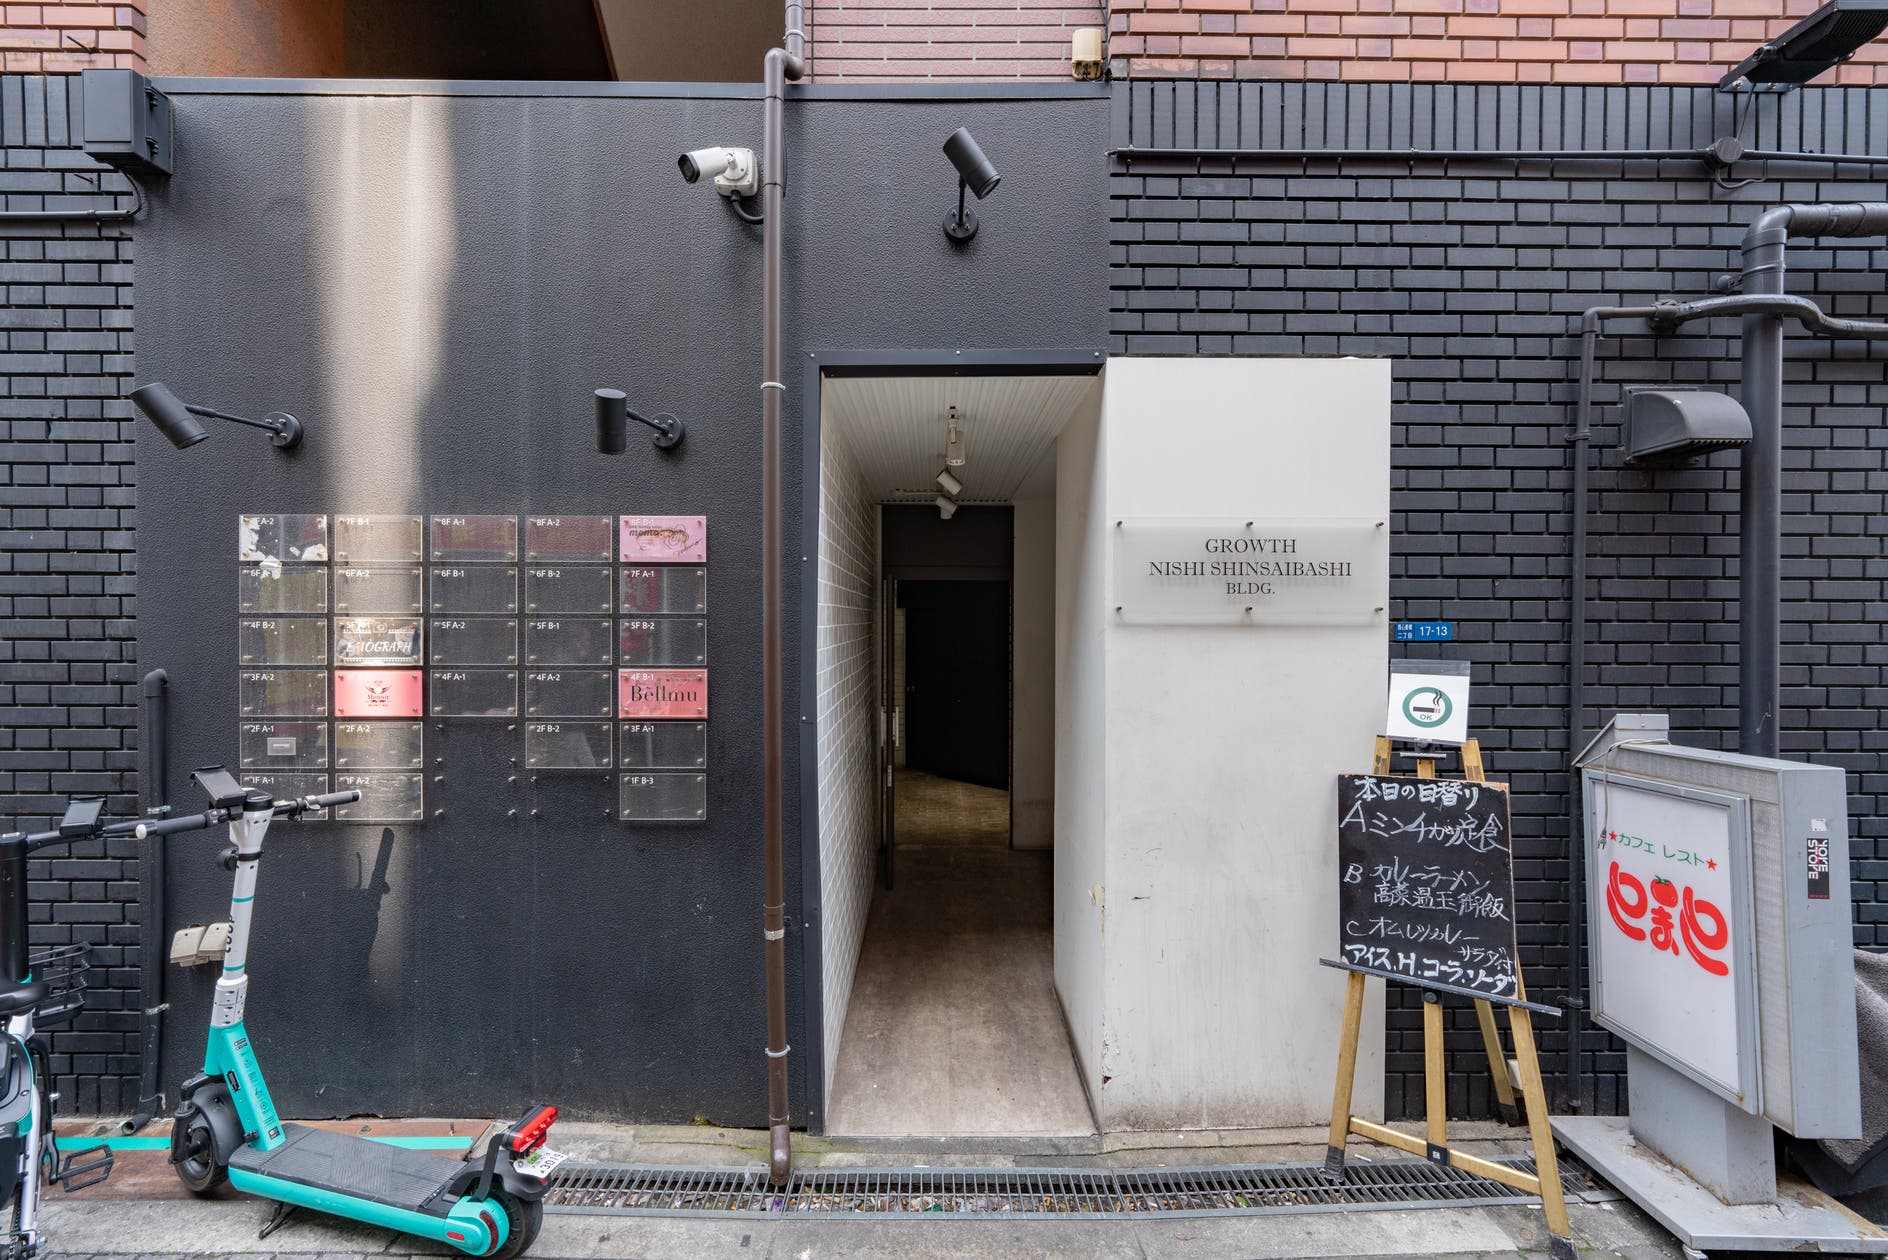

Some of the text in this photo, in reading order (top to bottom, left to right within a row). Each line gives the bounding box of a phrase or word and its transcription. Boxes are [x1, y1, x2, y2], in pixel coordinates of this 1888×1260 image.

[358, 517, 370, 526] B-1
[441, 517, 465, 526] 8F A-1
[536, 517, 561, 526] 8F A-2
[1204, 538, 1297, 554] GROWTH
[250, 569, 260, 578] 6F
[345, 569, 371, 578] 6F A-2
[441, 569, 465, 578] 6F B-1
[536, 569, 561, 578] 6F B-2
[631, 569, 656, 578] 7F A-1
[1148, 561, 1352, 577] NISHI SHINSAIBASHI
[1226, 582, 1276, 596] BLDG.
[250, 621, 275, 630] 4F B-2
[441, 621, 466, 630] 5F A-2
[536, 621, 560, 630] 5F B-1
[631, 621, 657, 630] 5F B-2
[1419, 626, 1448, 636] 17-13
[250, 673, 275, 681] 3F A-2
[441, 673, 465, 681] 4F A-1
[536, 673, 561, 681] 4F A-2
[631, 673, 656, 681] 4F B-1
[250, 724, 274, 733] 2F A-1
[345, 724, 371, 733] 2F A-2
[536, 724, 561, 733] 2F B-2
[631, 724, 656, 733] 3F A-1
[250, 776, 274, 785] 1F A-1
[345, 776, 371, 785] 1F A-2
[631, 776, 657, 785] 1F B-3
[1353, 776, 1479, 812] 本日の日替り
[1339, 800, 1366, 833] A
[1618, 832, 1706, 867] カフェ レスト
[1343, 856, 1491, 896] B カレーラーメン
[1606, 861, 1729, 976] とまと
[1346, 920, 1368, 936] C
